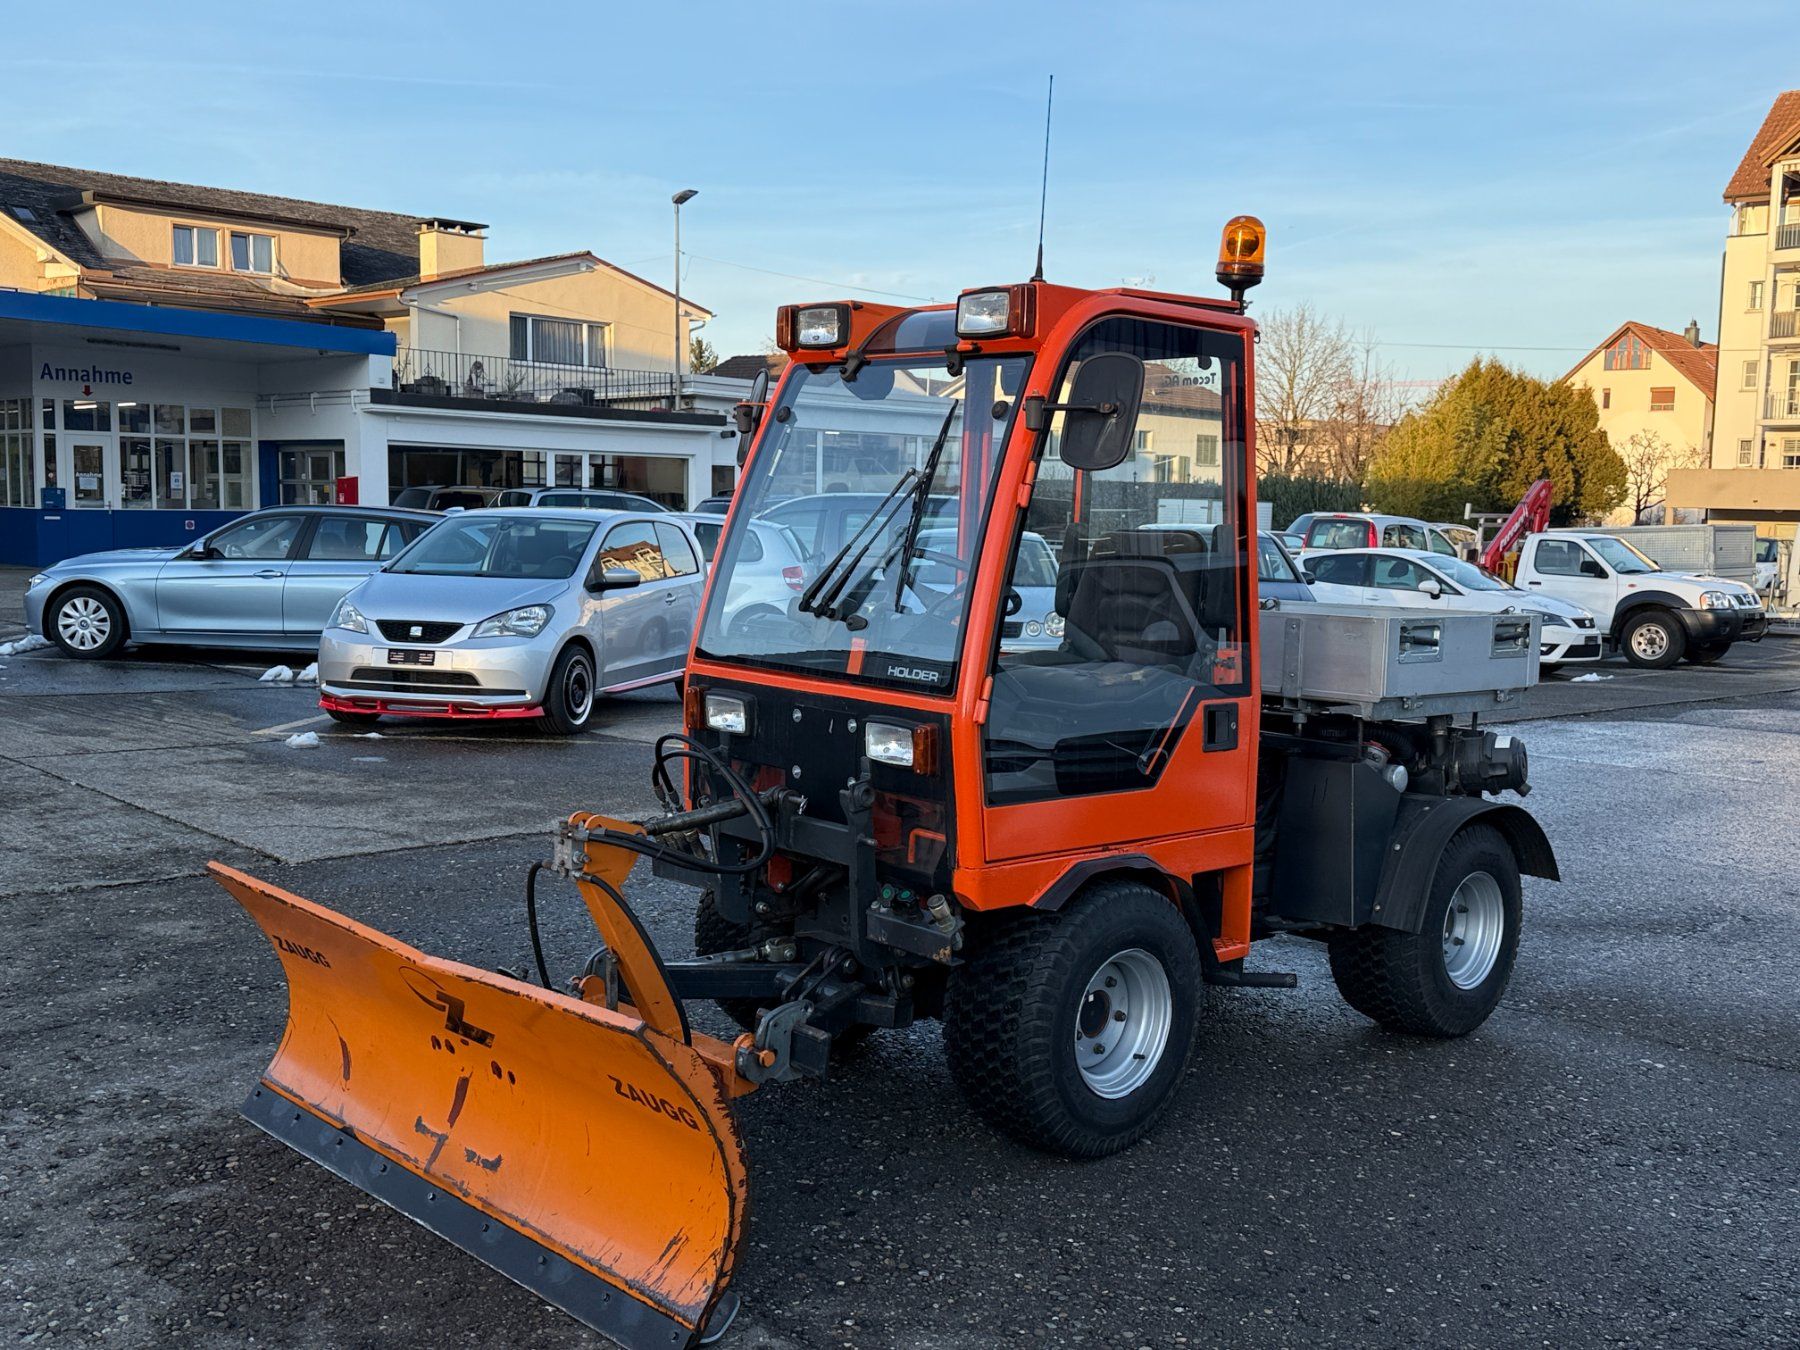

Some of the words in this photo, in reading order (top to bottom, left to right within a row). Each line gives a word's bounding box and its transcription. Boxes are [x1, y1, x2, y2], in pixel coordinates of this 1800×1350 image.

[40, 362, 133, 385] Annahme
[887, 665, 939, 683] HOLDER
[272, 934, 332, 969] ZAUGG
[607, 1074, 701, 1132] ZAUGG
